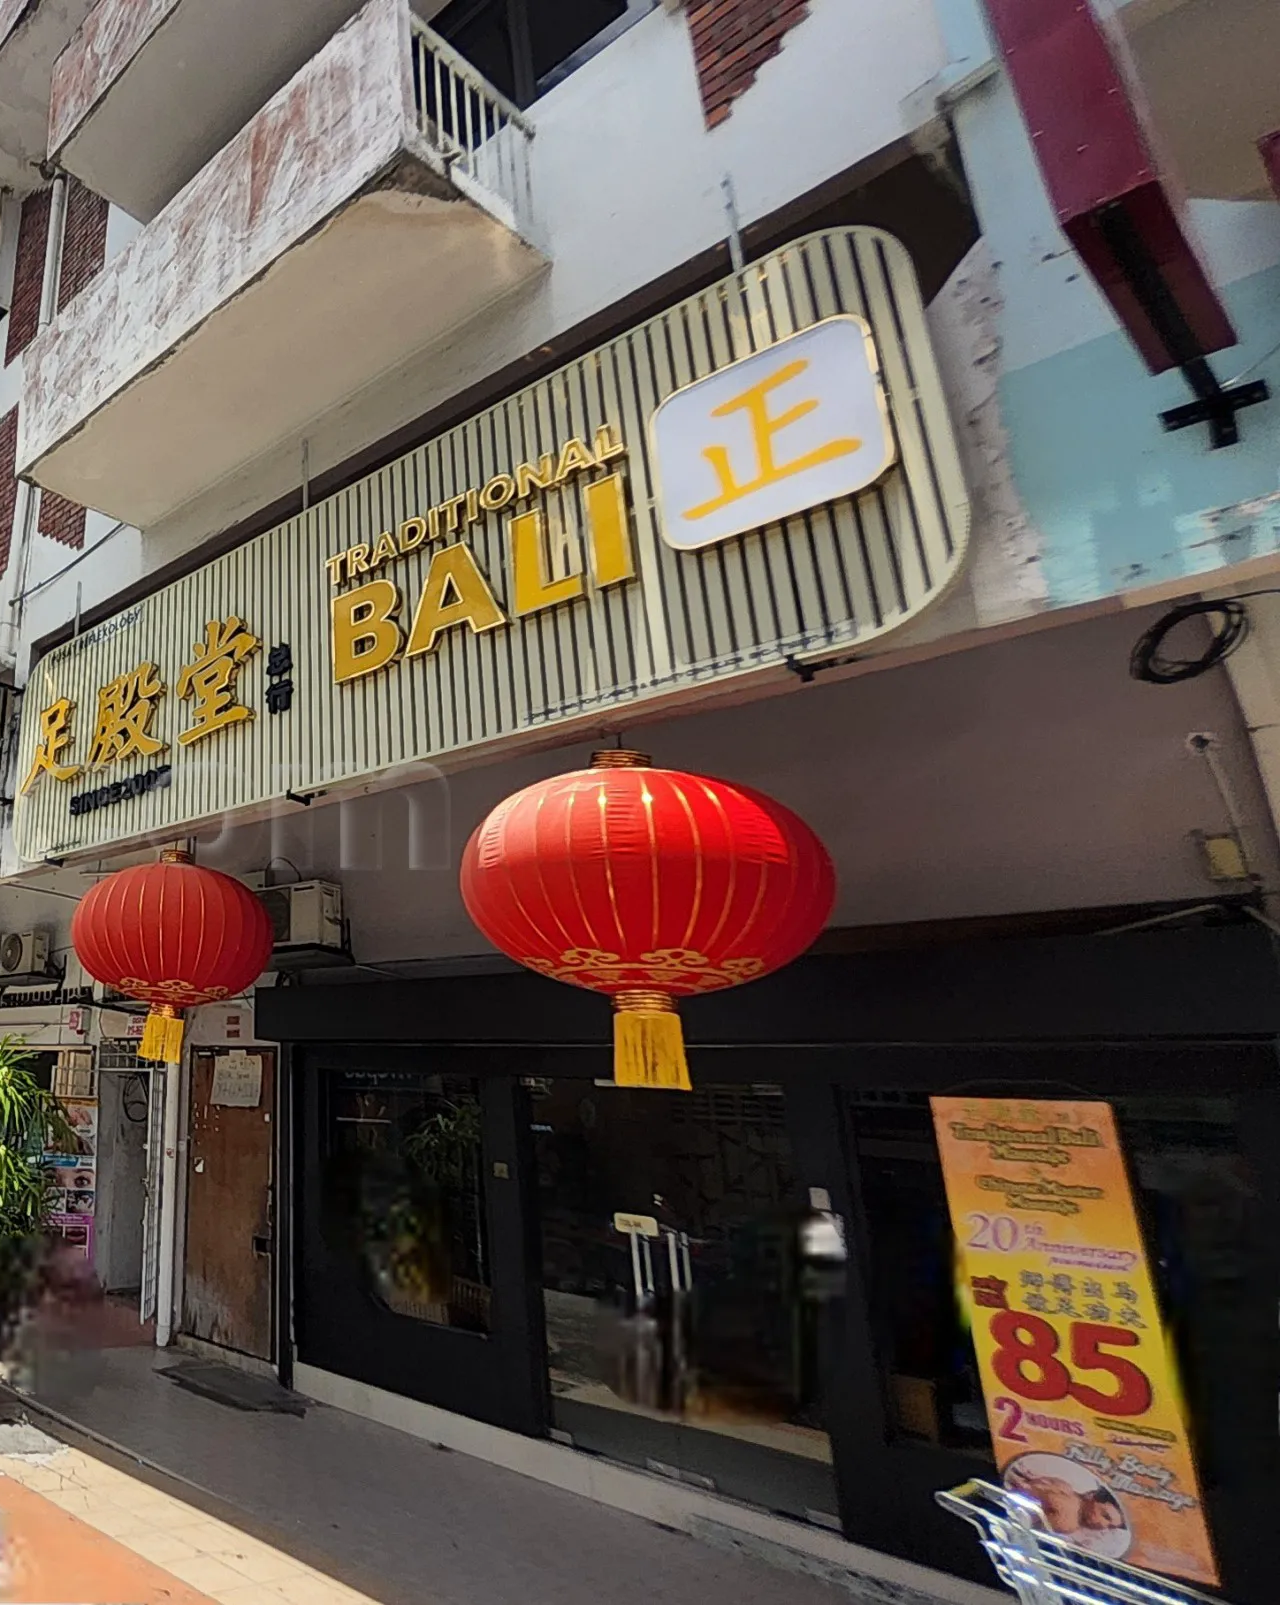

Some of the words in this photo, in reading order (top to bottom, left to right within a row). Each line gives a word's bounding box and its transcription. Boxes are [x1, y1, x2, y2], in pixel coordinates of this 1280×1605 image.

[325, 424, 626, 587] TRADITIONAL
[681, 358, 862, 520] 正
[331, 472, 636, 684] BALI
[20, 616, 263, 796] 足殿堂
[966, 1213, 1019, 1252] 20
[989, 1309, 1154, 1417] 85
[993, 1396, 1029, 1443] 2
[1024, 1411, 1085, 1437] HOURS
